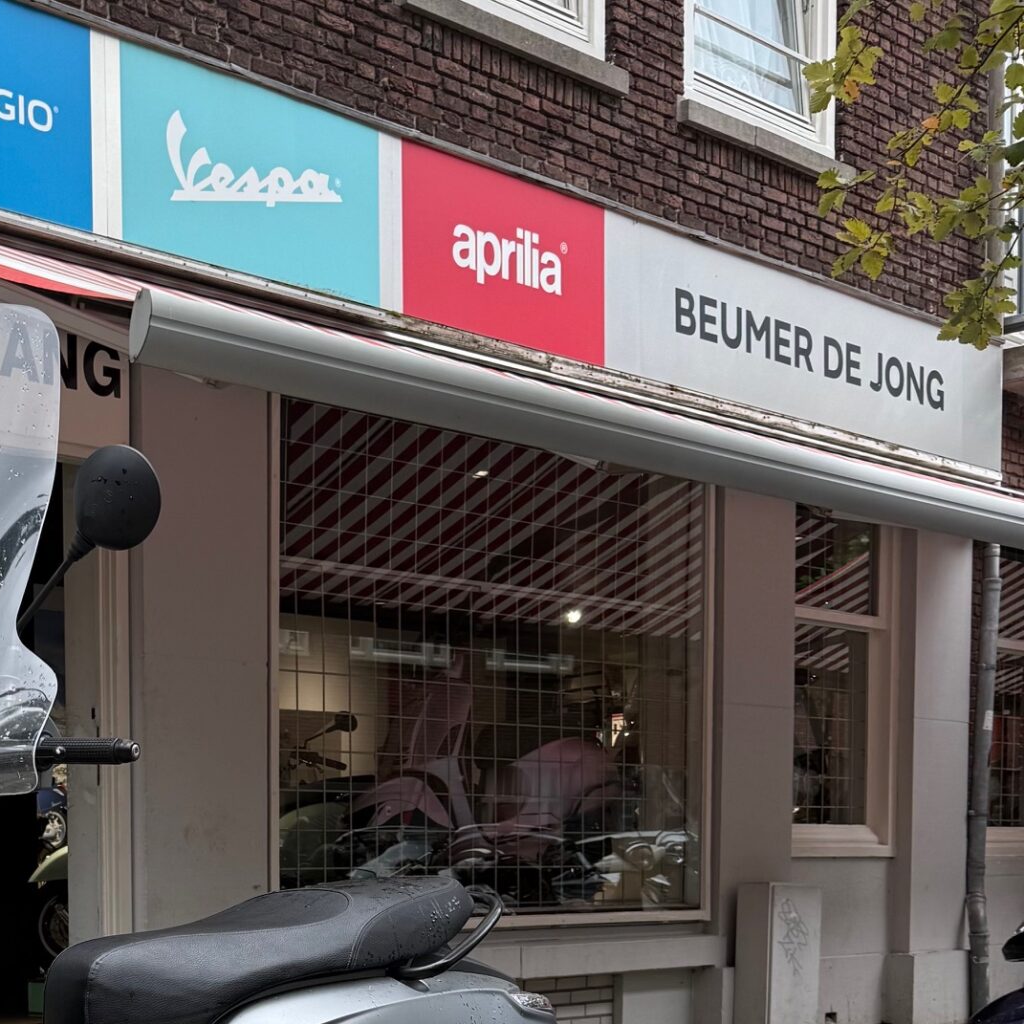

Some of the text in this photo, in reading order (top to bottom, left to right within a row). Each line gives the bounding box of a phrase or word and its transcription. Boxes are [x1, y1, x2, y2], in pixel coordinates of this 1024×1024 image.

[166, 110, 343, 207] Vespa
[452, 223, 562, 296] aprilia
[675, 287, 945, 412] BEUMER DE JONG
